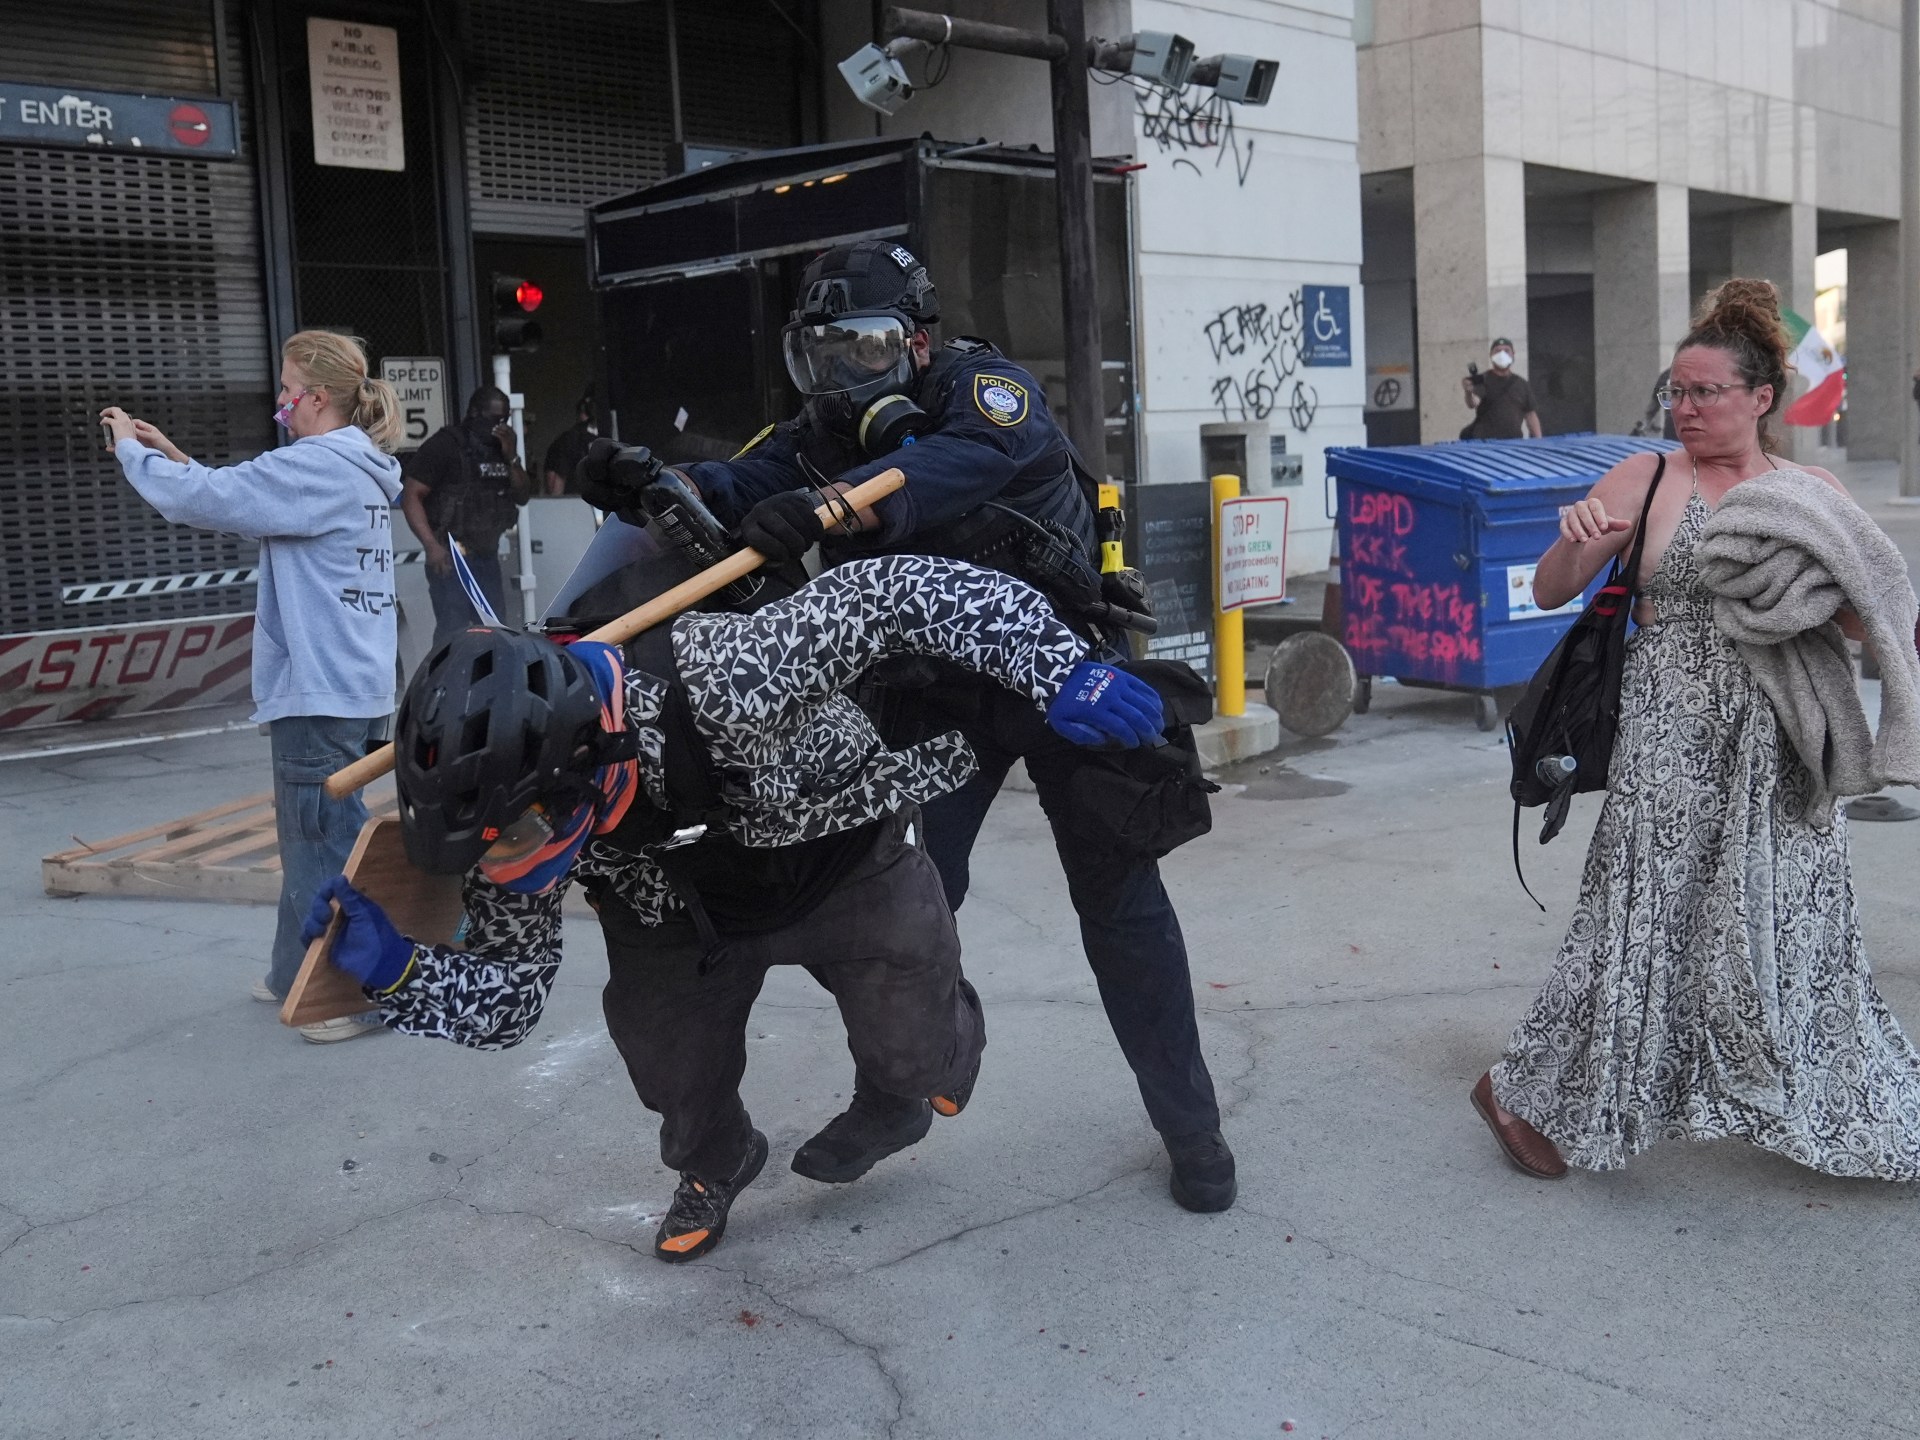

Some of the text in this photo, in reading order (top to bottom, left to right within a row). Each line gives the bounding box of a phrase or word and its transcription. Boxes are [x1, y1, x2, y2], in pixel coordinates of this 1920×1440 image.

[343, 26, 363, 39] NO
[20, 99, 113, 130] ENTER
[388, 368, 439, 381] SPEED
[980, 378, 1023, 398] POLICE
[1248, 540, 1272, 553] GREEN
[34, 625, 216, 692] STOP
